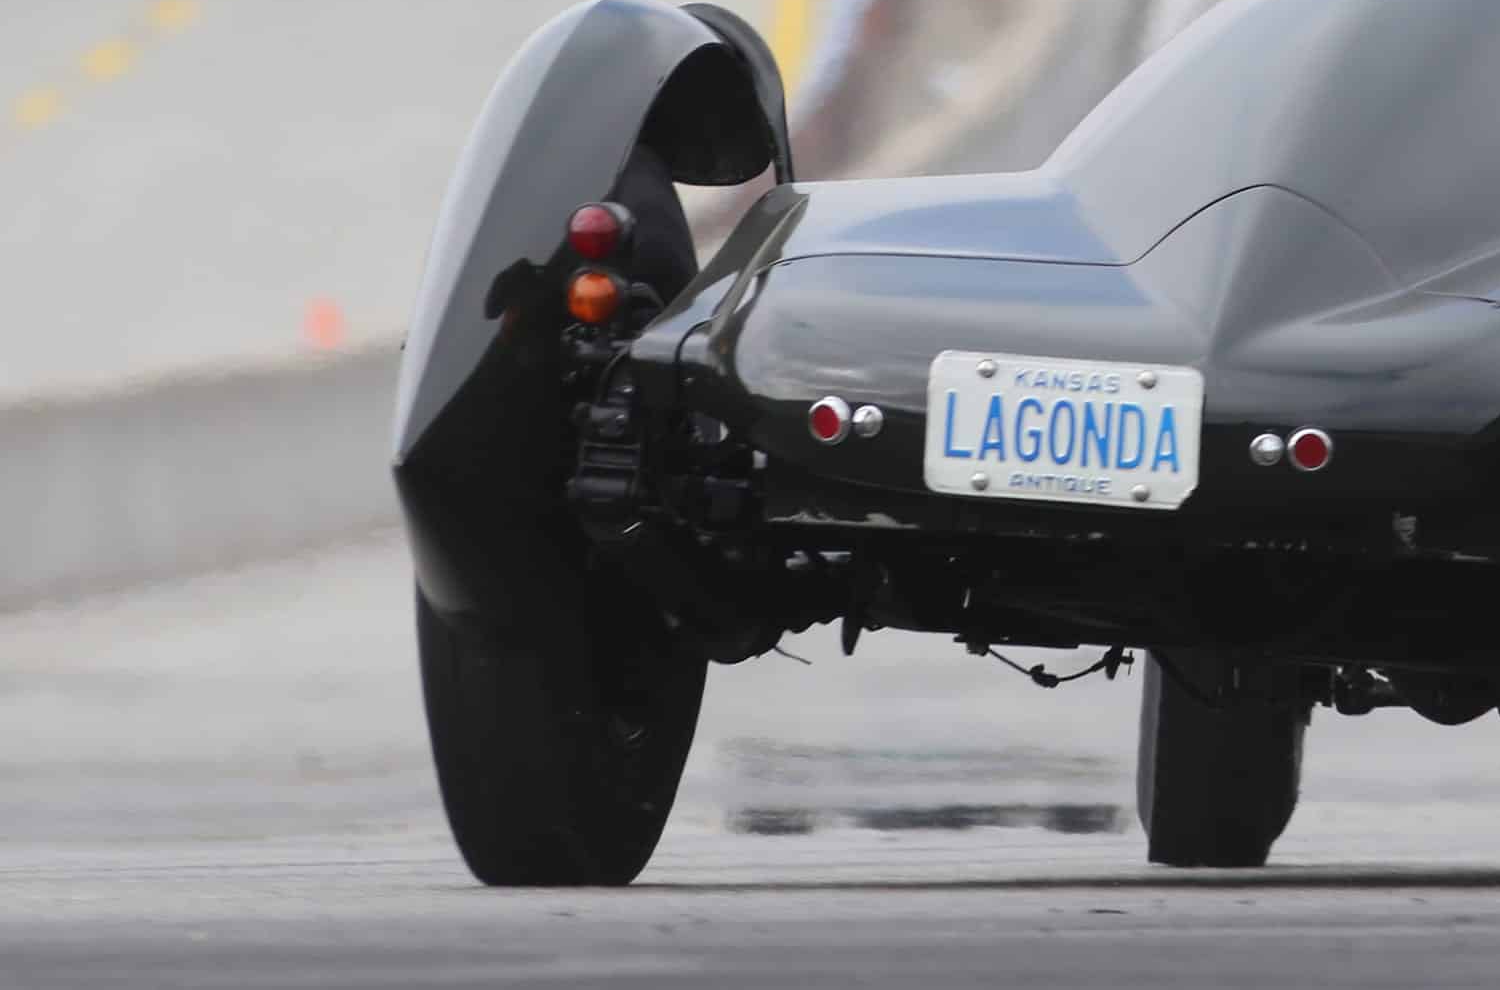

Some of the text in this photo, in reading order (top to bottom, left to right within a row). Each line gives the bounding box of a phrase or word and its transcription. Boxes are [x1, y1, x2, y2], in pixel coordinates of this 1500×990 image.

[1013, 368, 1121, 394] KANSAS
[943, 390, 1180, 473] LAGONDA
[1007, 472, 1113, 496] ANTIQUE
